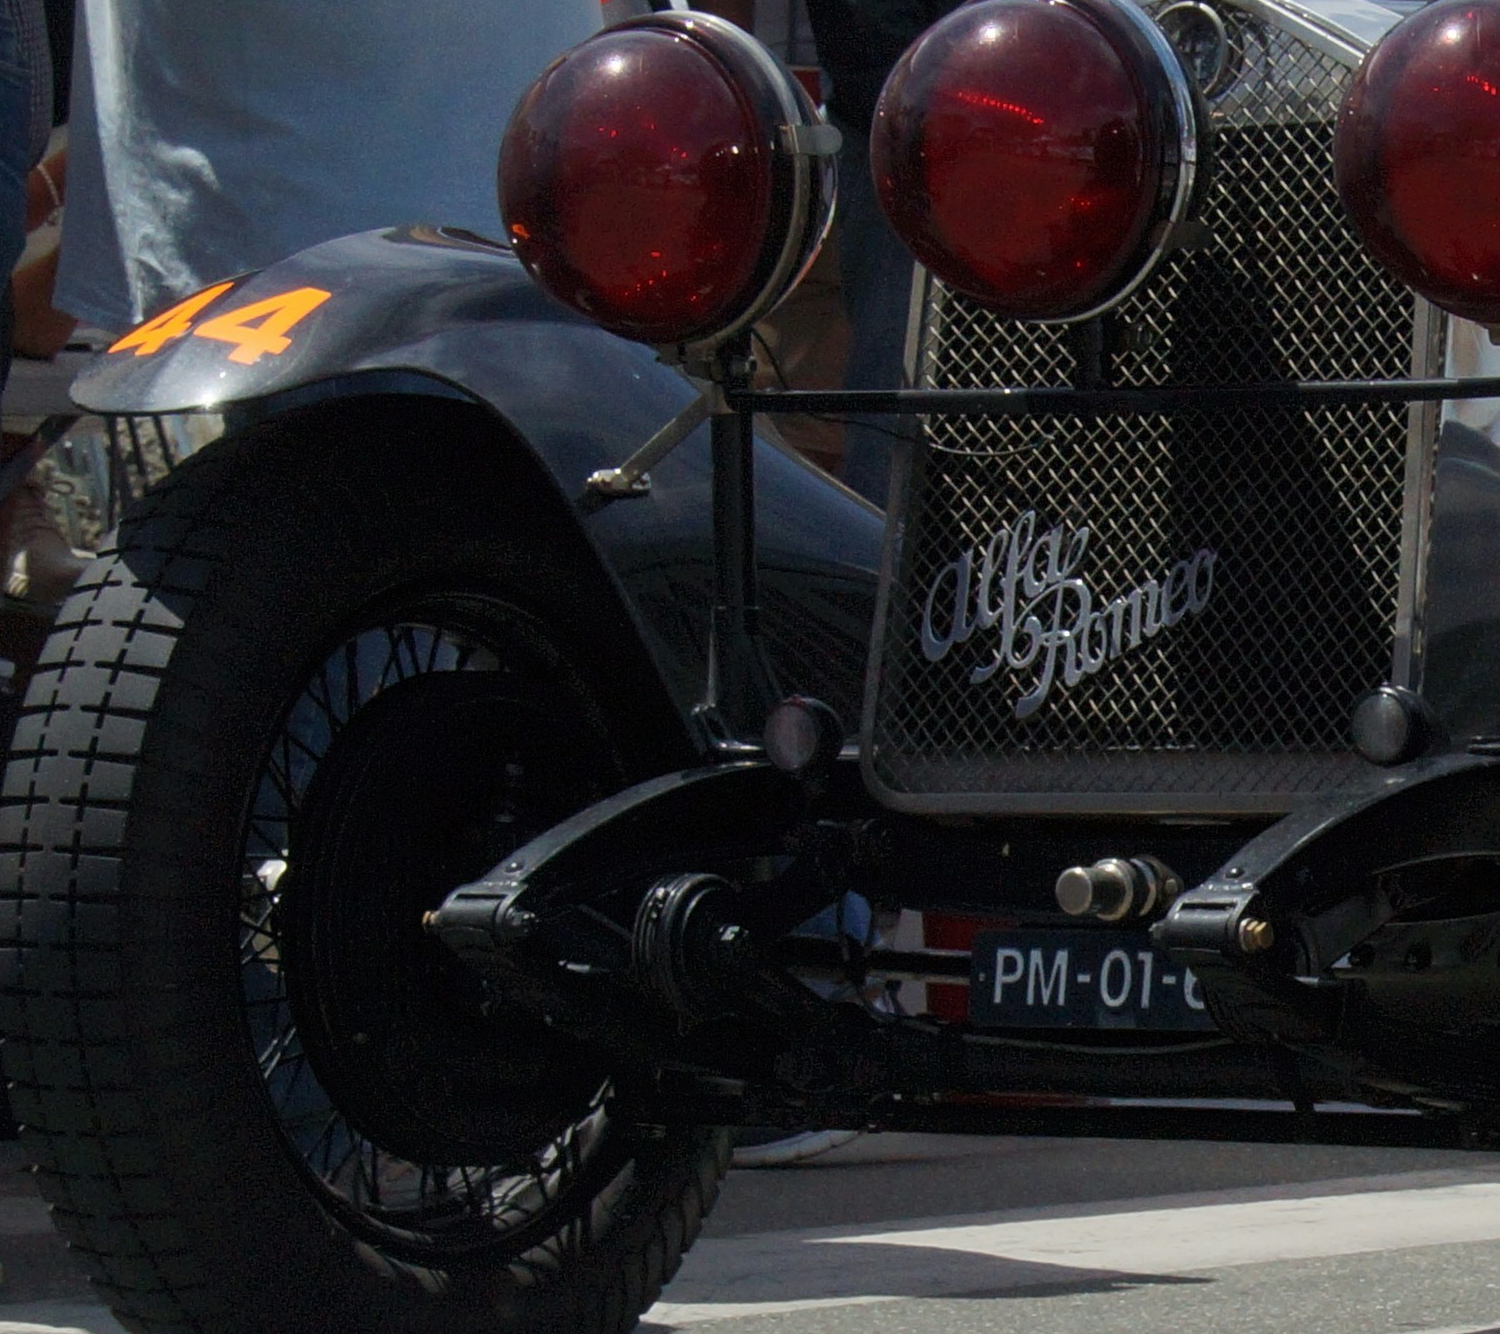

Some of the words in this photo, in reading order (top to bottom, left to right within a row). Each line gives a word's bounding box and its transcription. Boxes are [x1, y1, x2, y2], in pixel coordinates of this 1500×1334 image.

[107, 281, 332, 365] 44
[920, 509, 1090, 684] Alfa
[1012, 547, 1218, 719] Romeo
